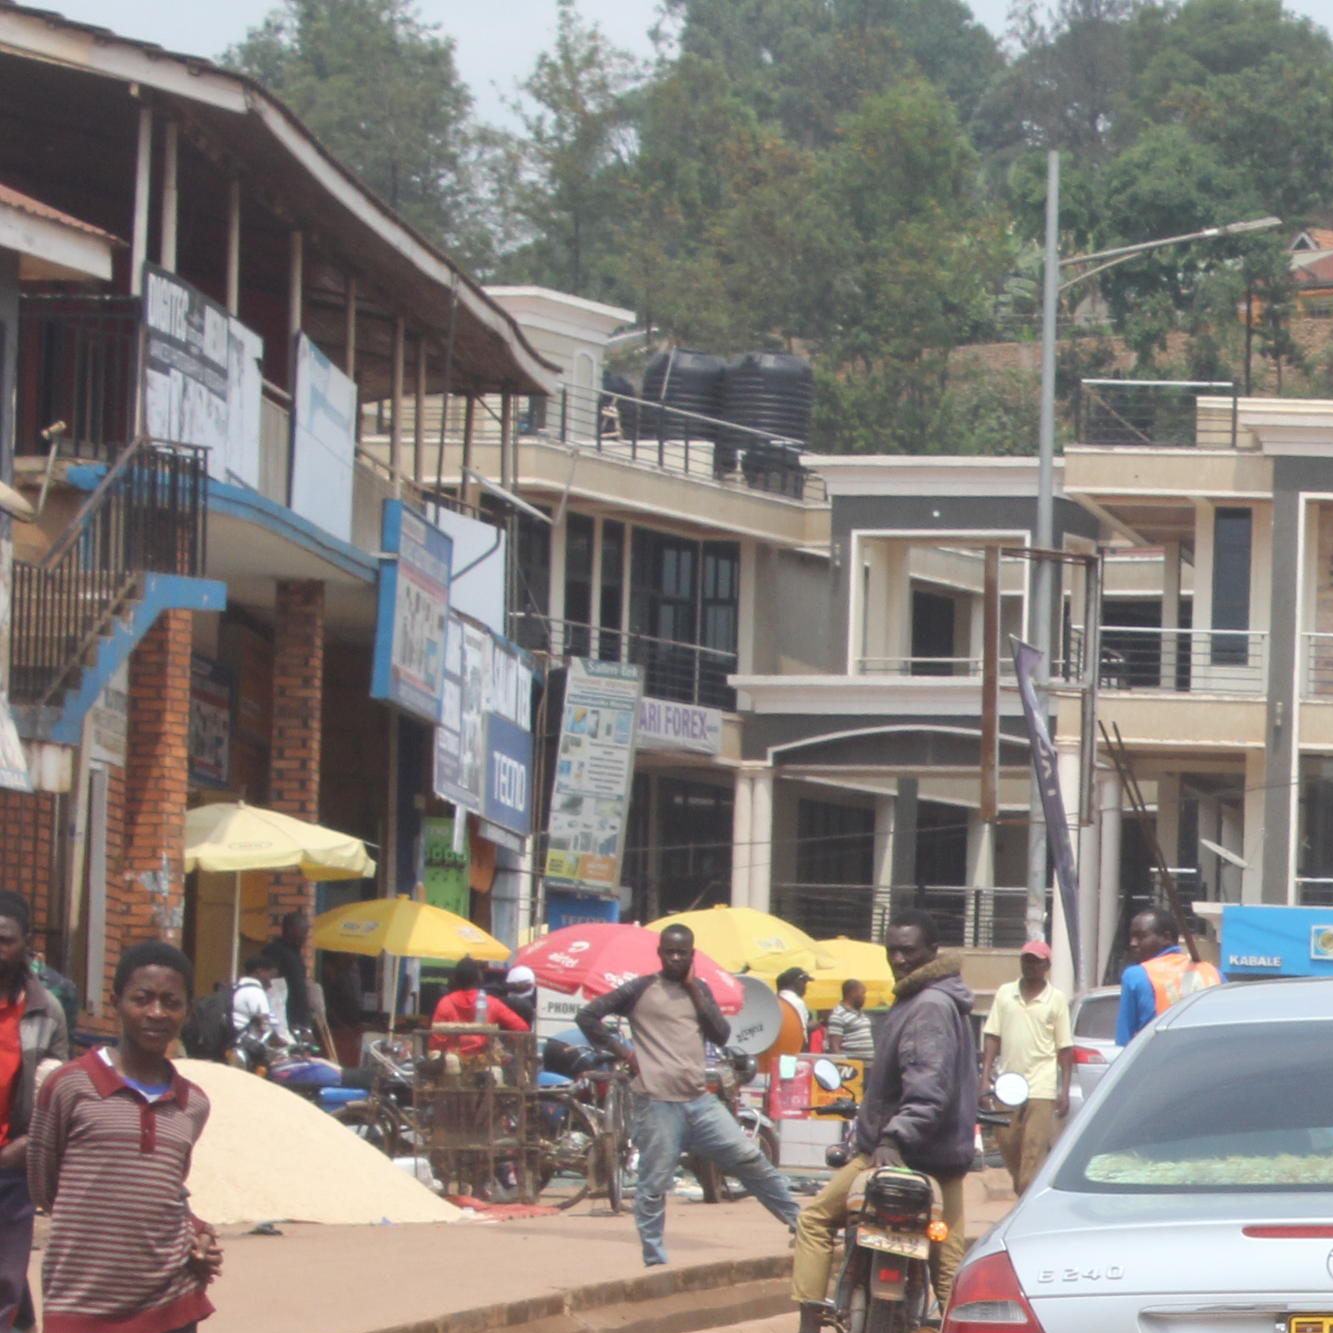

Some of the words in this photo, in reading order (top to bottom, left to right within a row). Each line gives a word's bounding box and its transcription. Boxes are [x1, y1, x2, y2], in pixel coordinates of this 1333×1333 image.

[664, 706, 709, 740] FOREX
[1228, 954, 1282, 968] KABALE
[1037, 1268, 1056, 1284] E
[1061, 1264, 1126, 1282] 240
